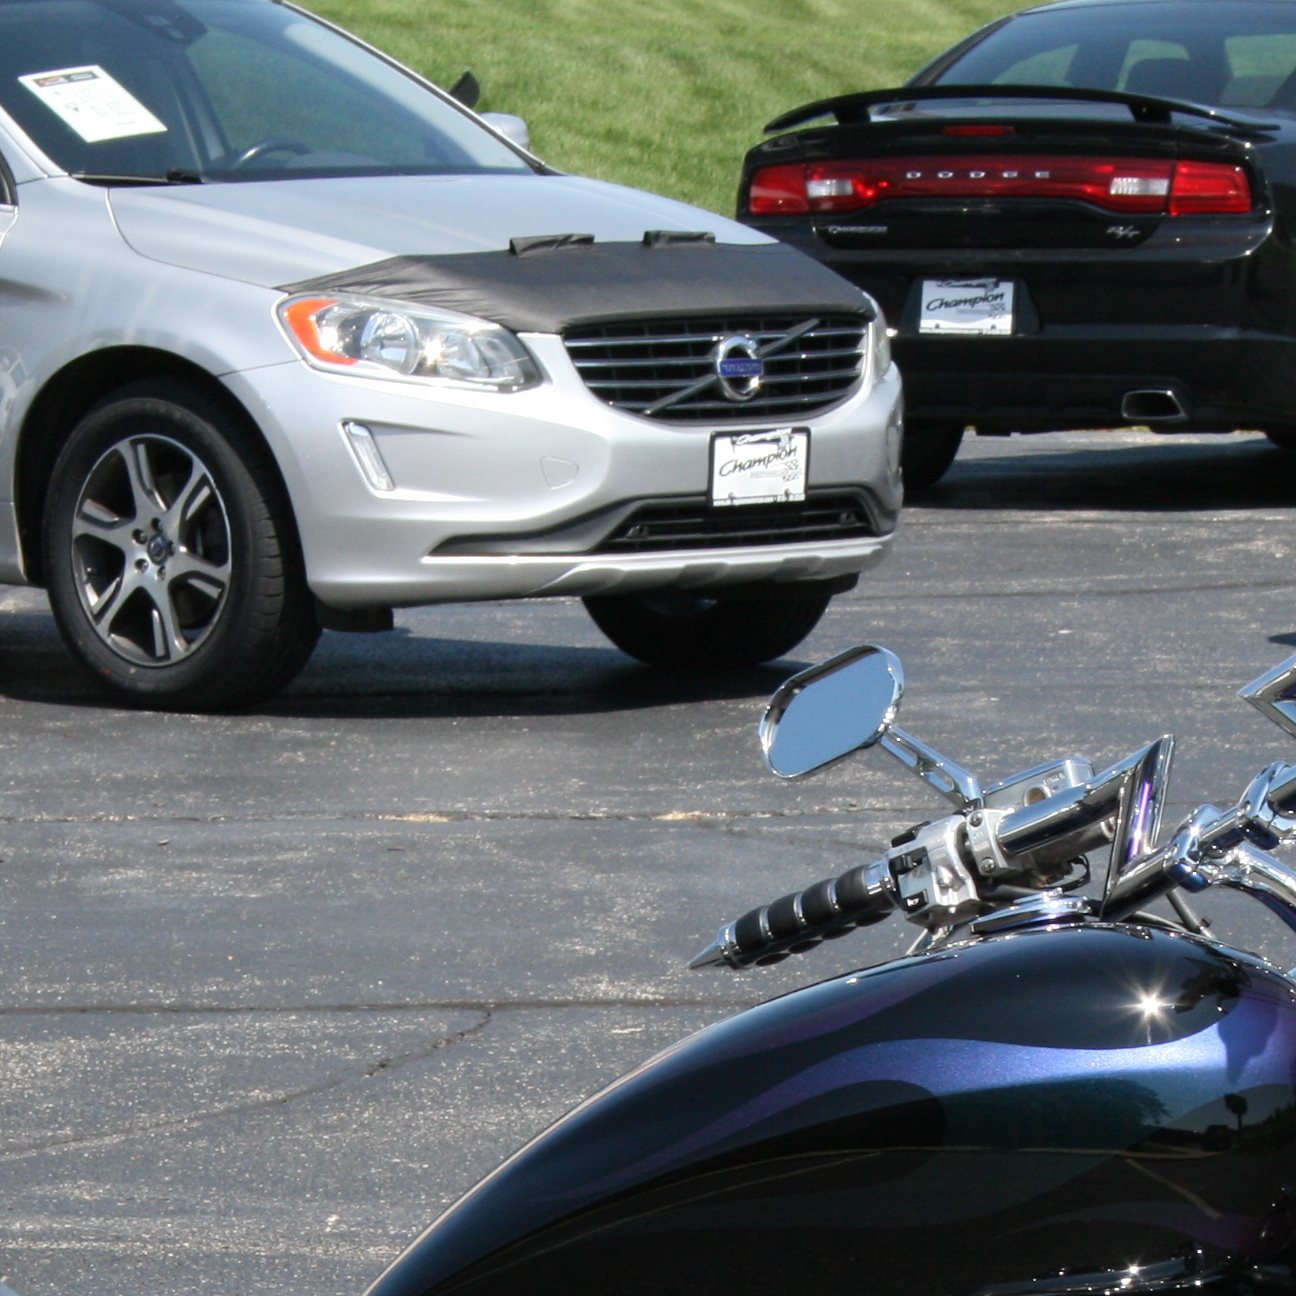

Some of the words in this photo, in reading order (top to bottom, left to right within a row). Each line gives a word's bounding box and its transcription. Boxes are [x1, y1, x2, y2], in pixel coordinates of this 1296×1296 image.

[906, 171, 1050, 179] DODGE
[926, 291, 1005, 312] Champion
[719, 446, 798, 478] Champion
